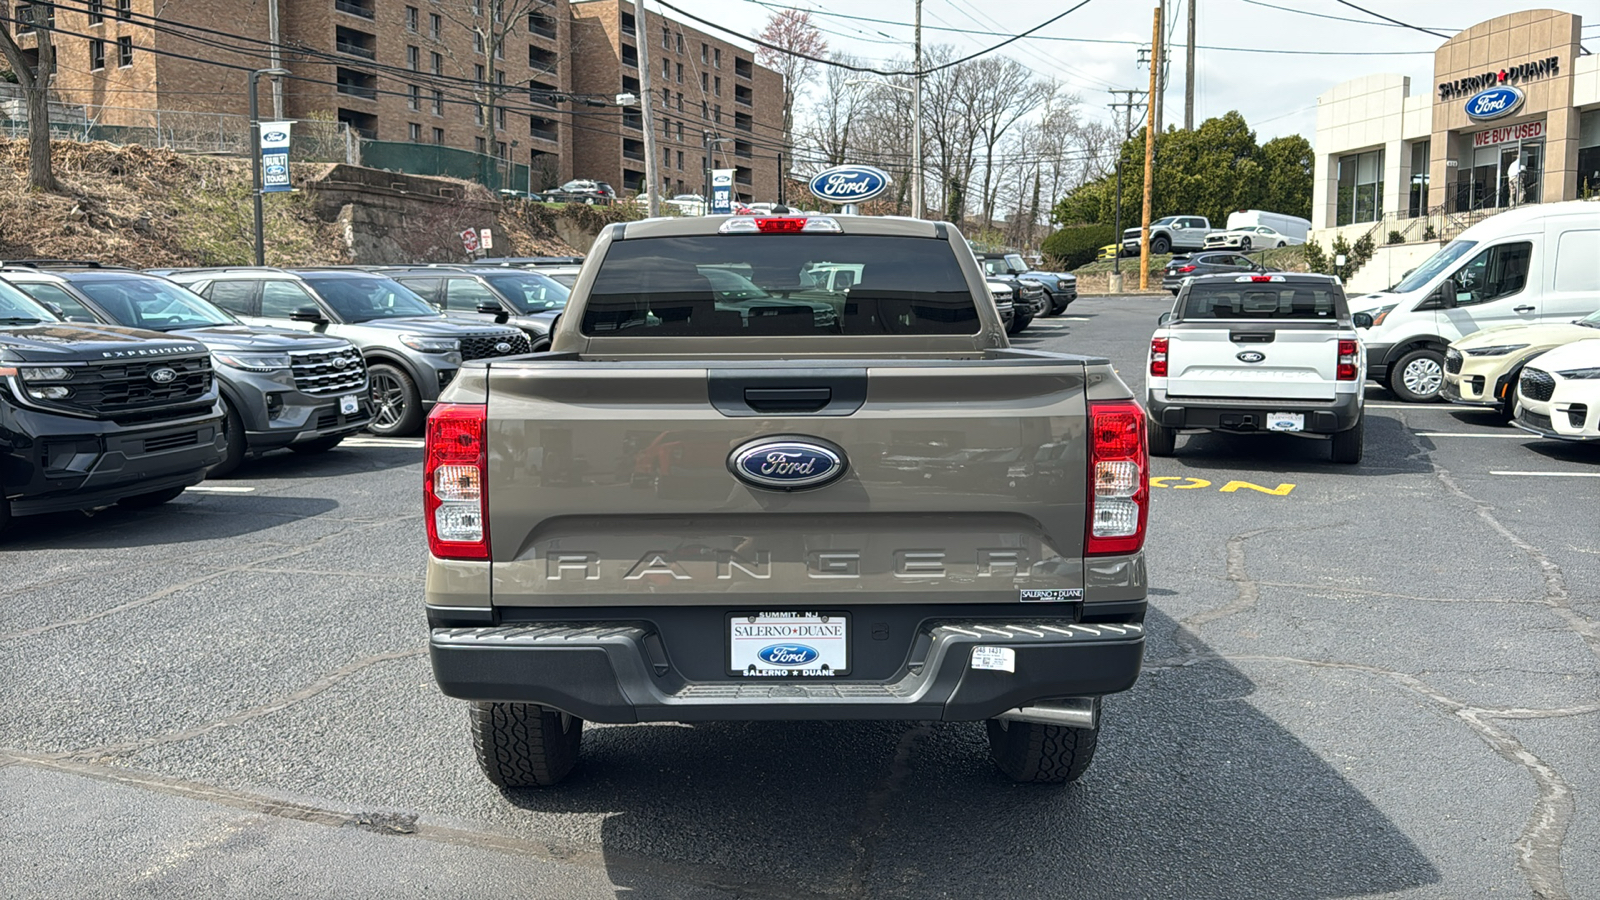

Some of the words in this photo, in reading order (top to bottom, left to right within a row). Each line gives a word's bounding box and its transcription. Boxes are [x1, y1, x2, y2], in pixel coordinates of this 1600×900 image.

[1438, 72, 1498, 98] SALERNO
[1508, 56, 1559, 79] DUANE
[1474, 92, 1507, 114] Ford
[1475, 131, 1490, 146] WE
[1492, 127, 1512, 143] BUY
[1514, 122, 1542, 139] USED
[265, 156, 285, 166] BUILT
[266, 174, 287, 183] TOUGH
[824, 173, 870, 194] Ford
[103, 346, 195, 358] EXPEDITION
[761, 451, 816, 475] Ford
[545, 549, 1031, 580] RANGER
[1022, 590, 1053, 598] SALERNO
[1058, 589, 1082, 597] DUANE
[734, 626, 791, 637] SALERNO
[799, 626, 842, 637] DUANE
[769, 647, 807, 662] Ford
[743, 669, 788, 677] SALERNO
[802, 669, 835, 677] DUANE
